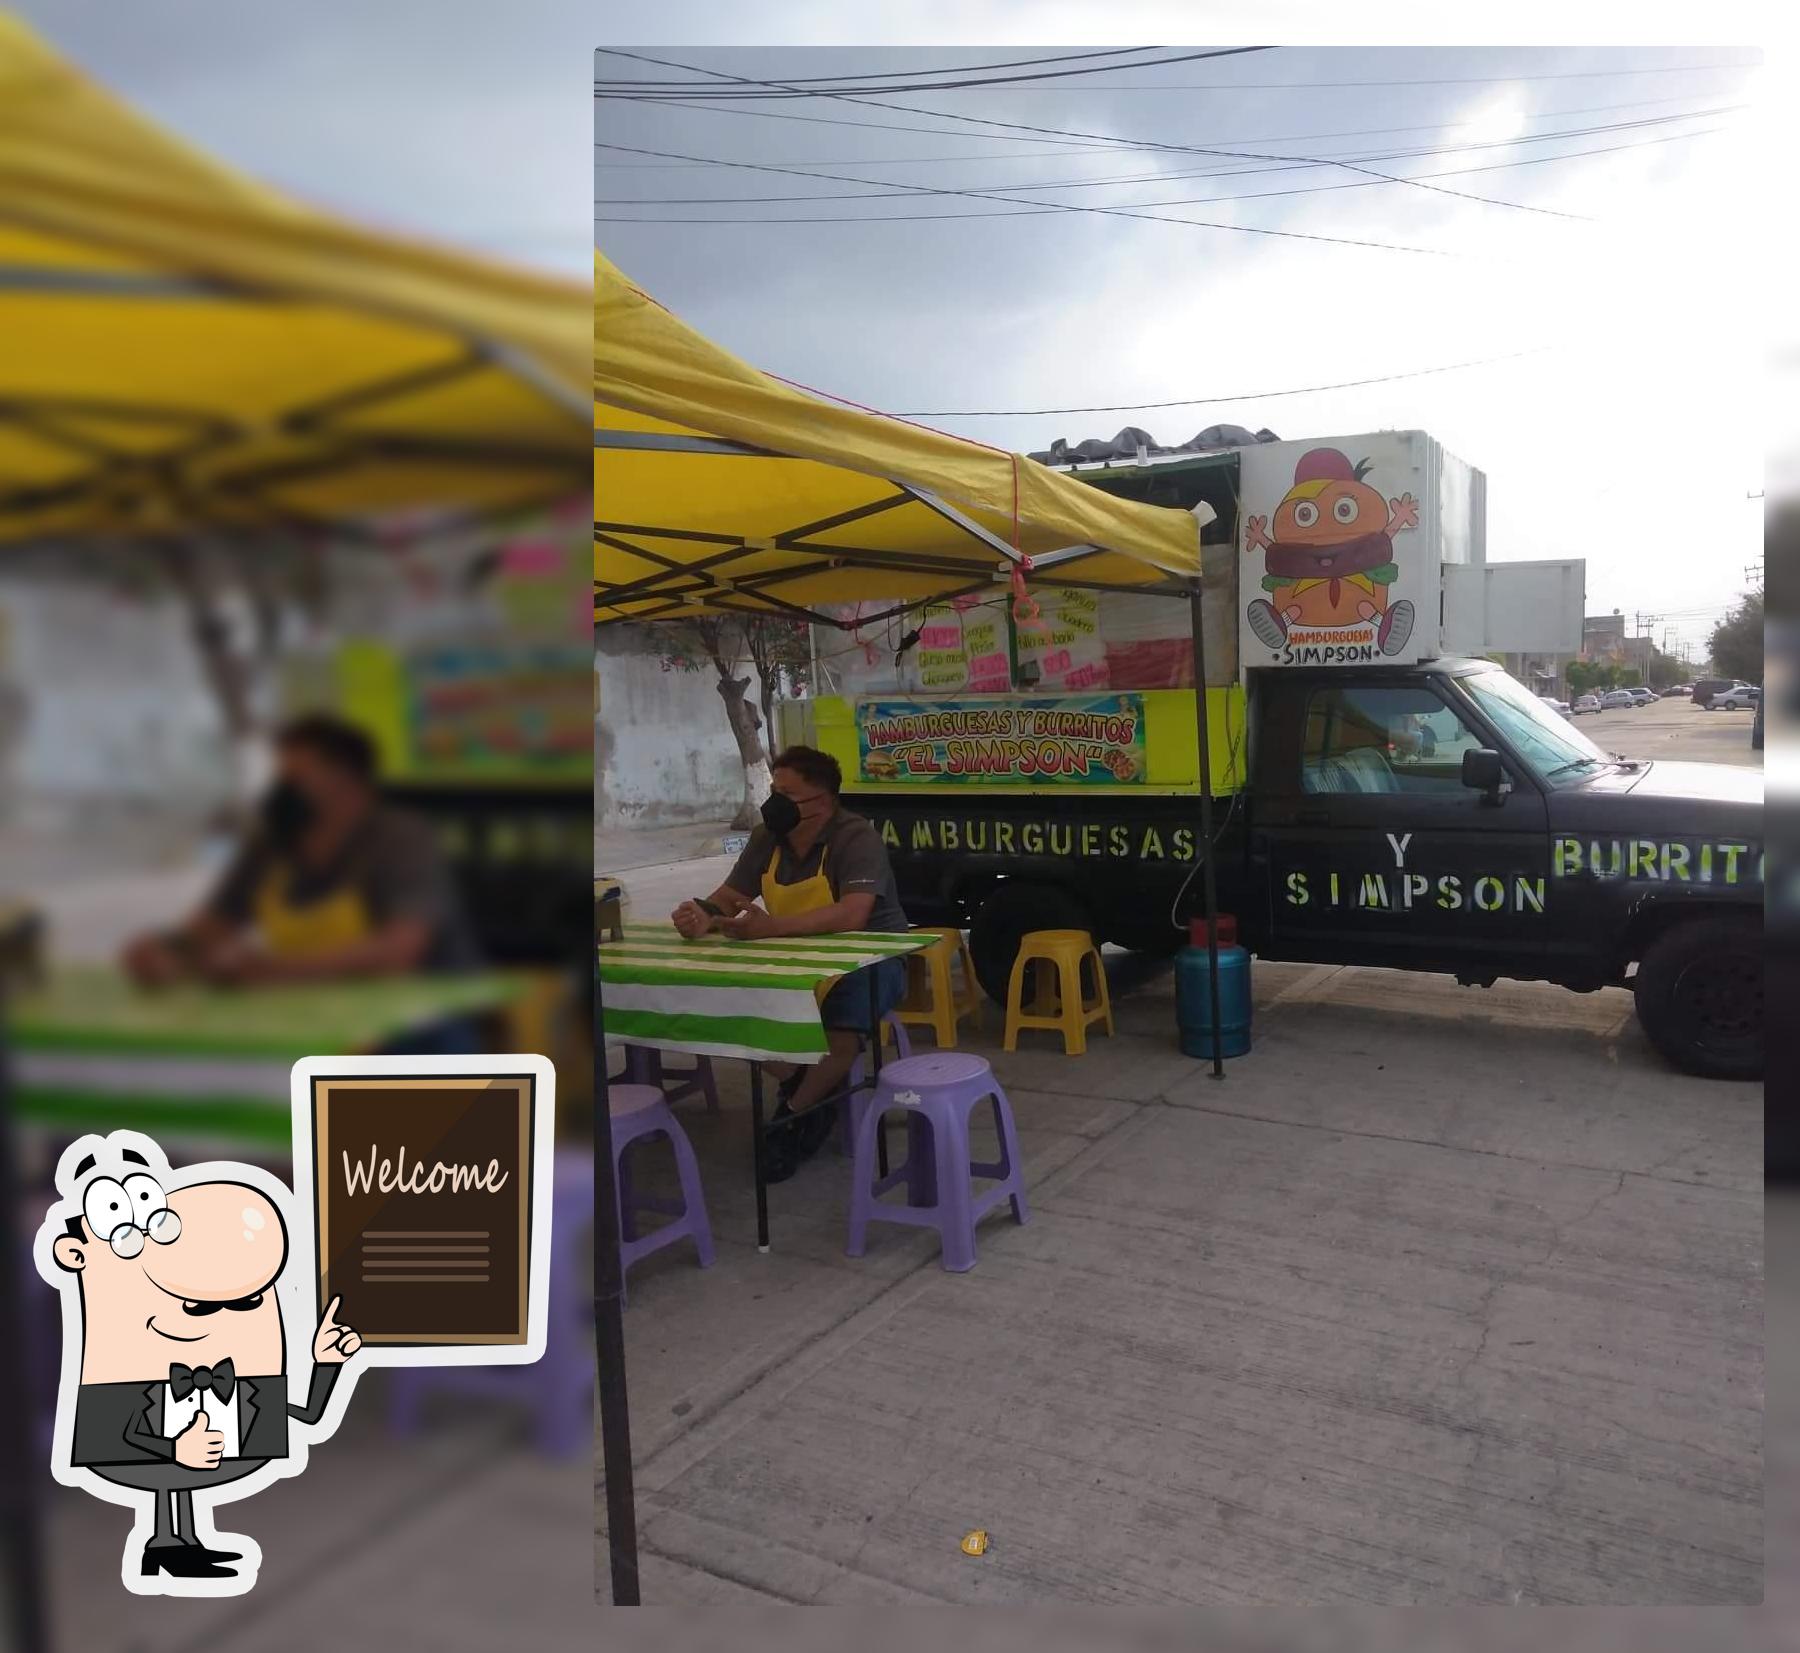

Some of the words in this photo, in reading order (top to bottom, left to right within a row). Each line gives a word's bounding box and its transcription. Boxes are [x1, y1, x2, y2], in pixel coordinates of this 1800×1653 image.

[1283, 644, 1373, 665] SIMPSON
[1288, 627, 1374, 645] HAMBURGUESAS
[865, 711, 1012, 748] HAMBURGUESAS
[1017, 710, 1032, 736] Y
[1034, 711, 1135, 745] BURRITOS
[870, 819, 1196, 861] AMBURGUESAS
[1386, 832, 1413, 868] Y
[1554, 838, 1764, 884] BURRIT
[1286, 872, 1545, 913] SIMPSON
